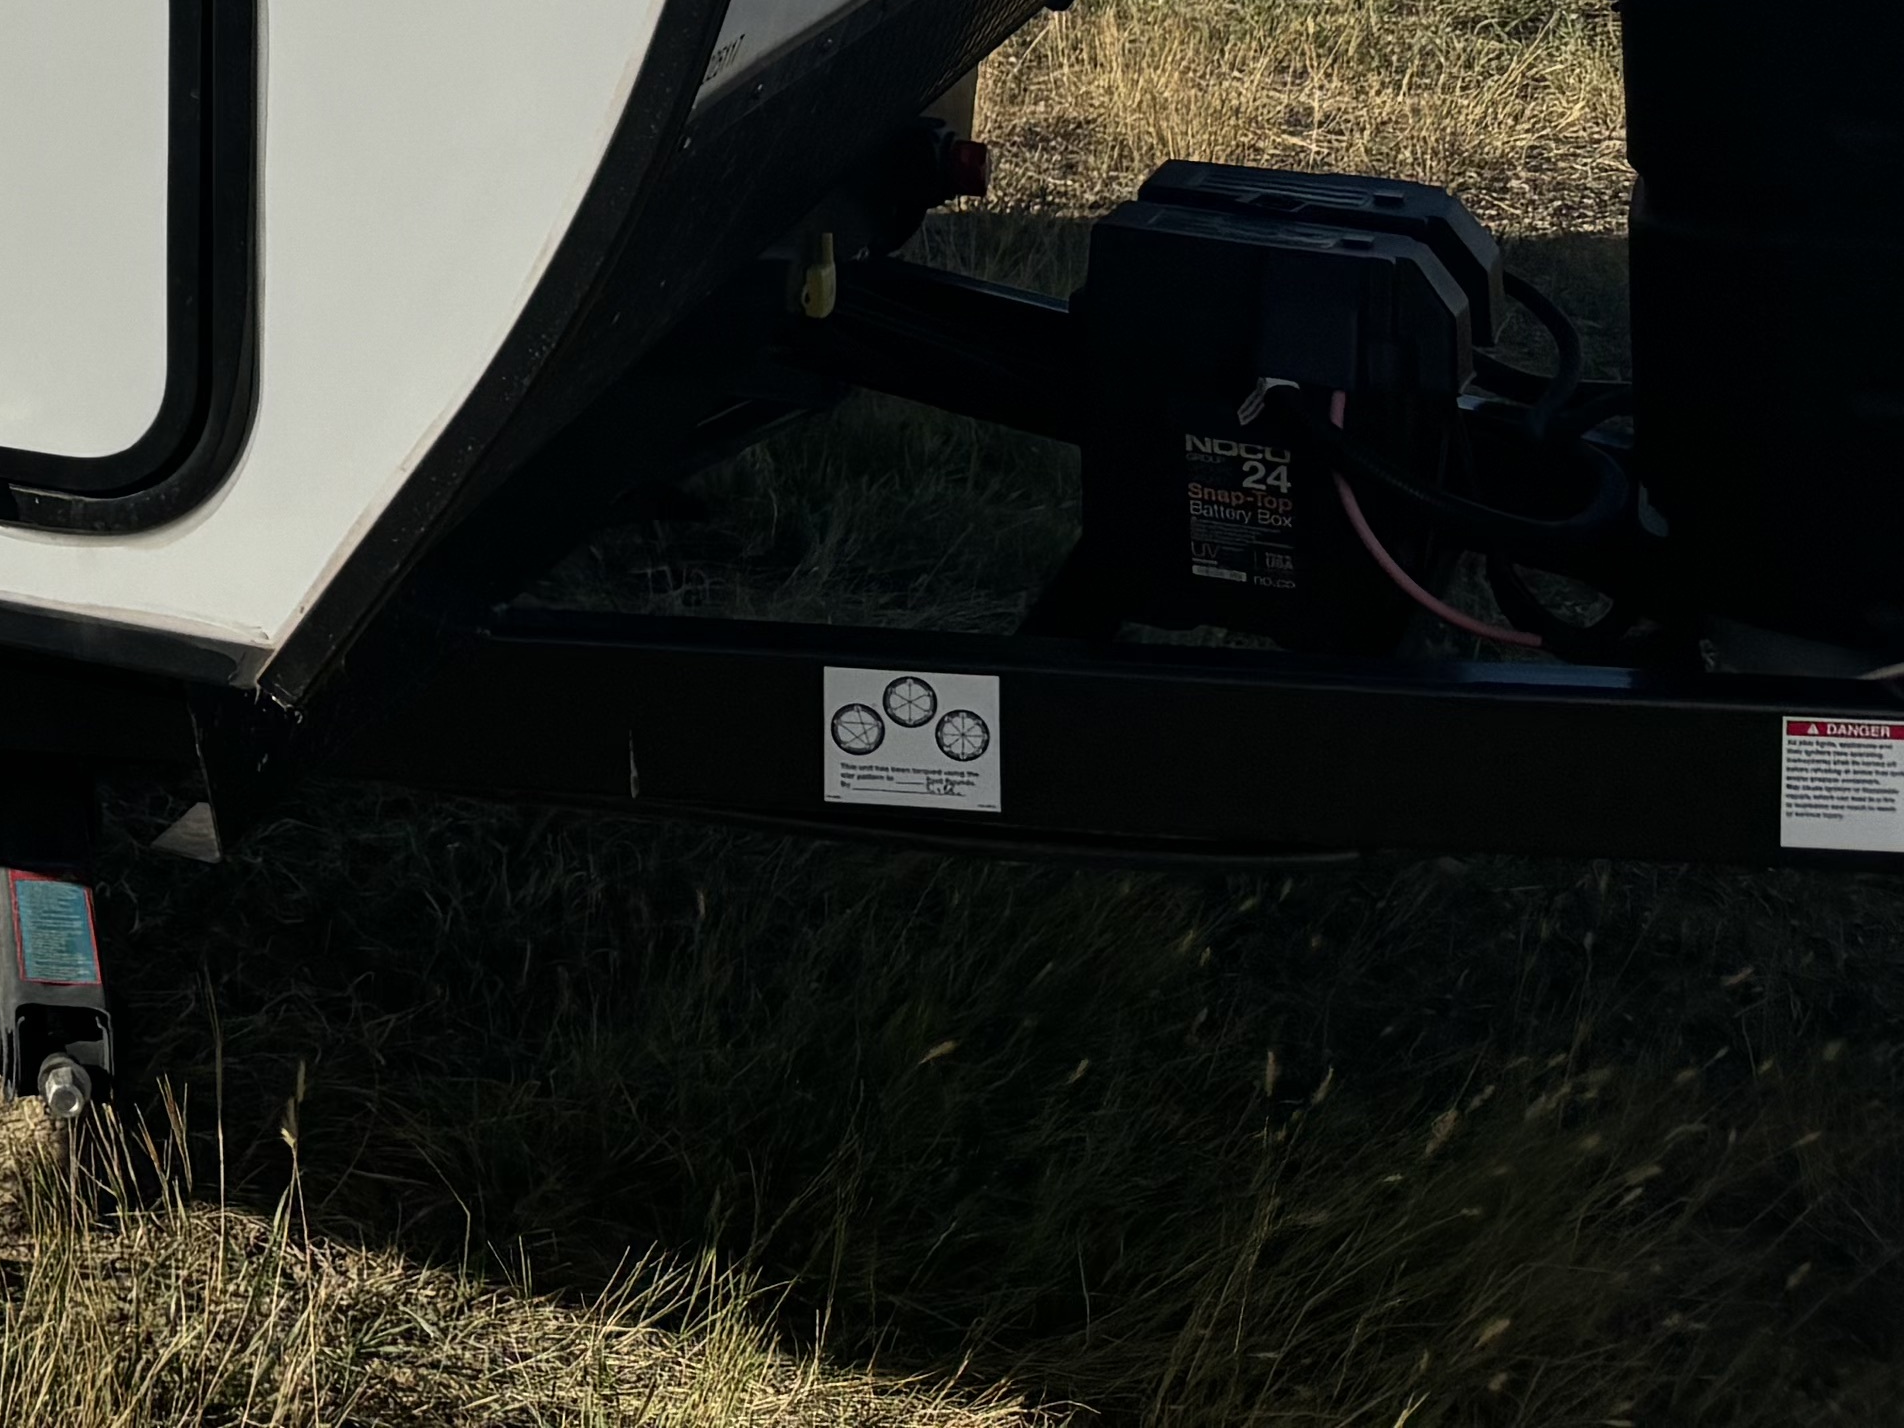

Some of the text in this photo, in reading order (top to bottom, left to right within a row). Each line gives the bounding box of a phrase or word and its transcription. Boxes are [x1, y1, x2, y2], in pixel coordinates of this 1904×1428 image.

[1242, 460, 1292, 494] 24
[1187, 482, 1293, 514] Snap-Top
[1190, 499, 1293, 528] Battery Box
[1826, 723, 1891, 738] DANGER
